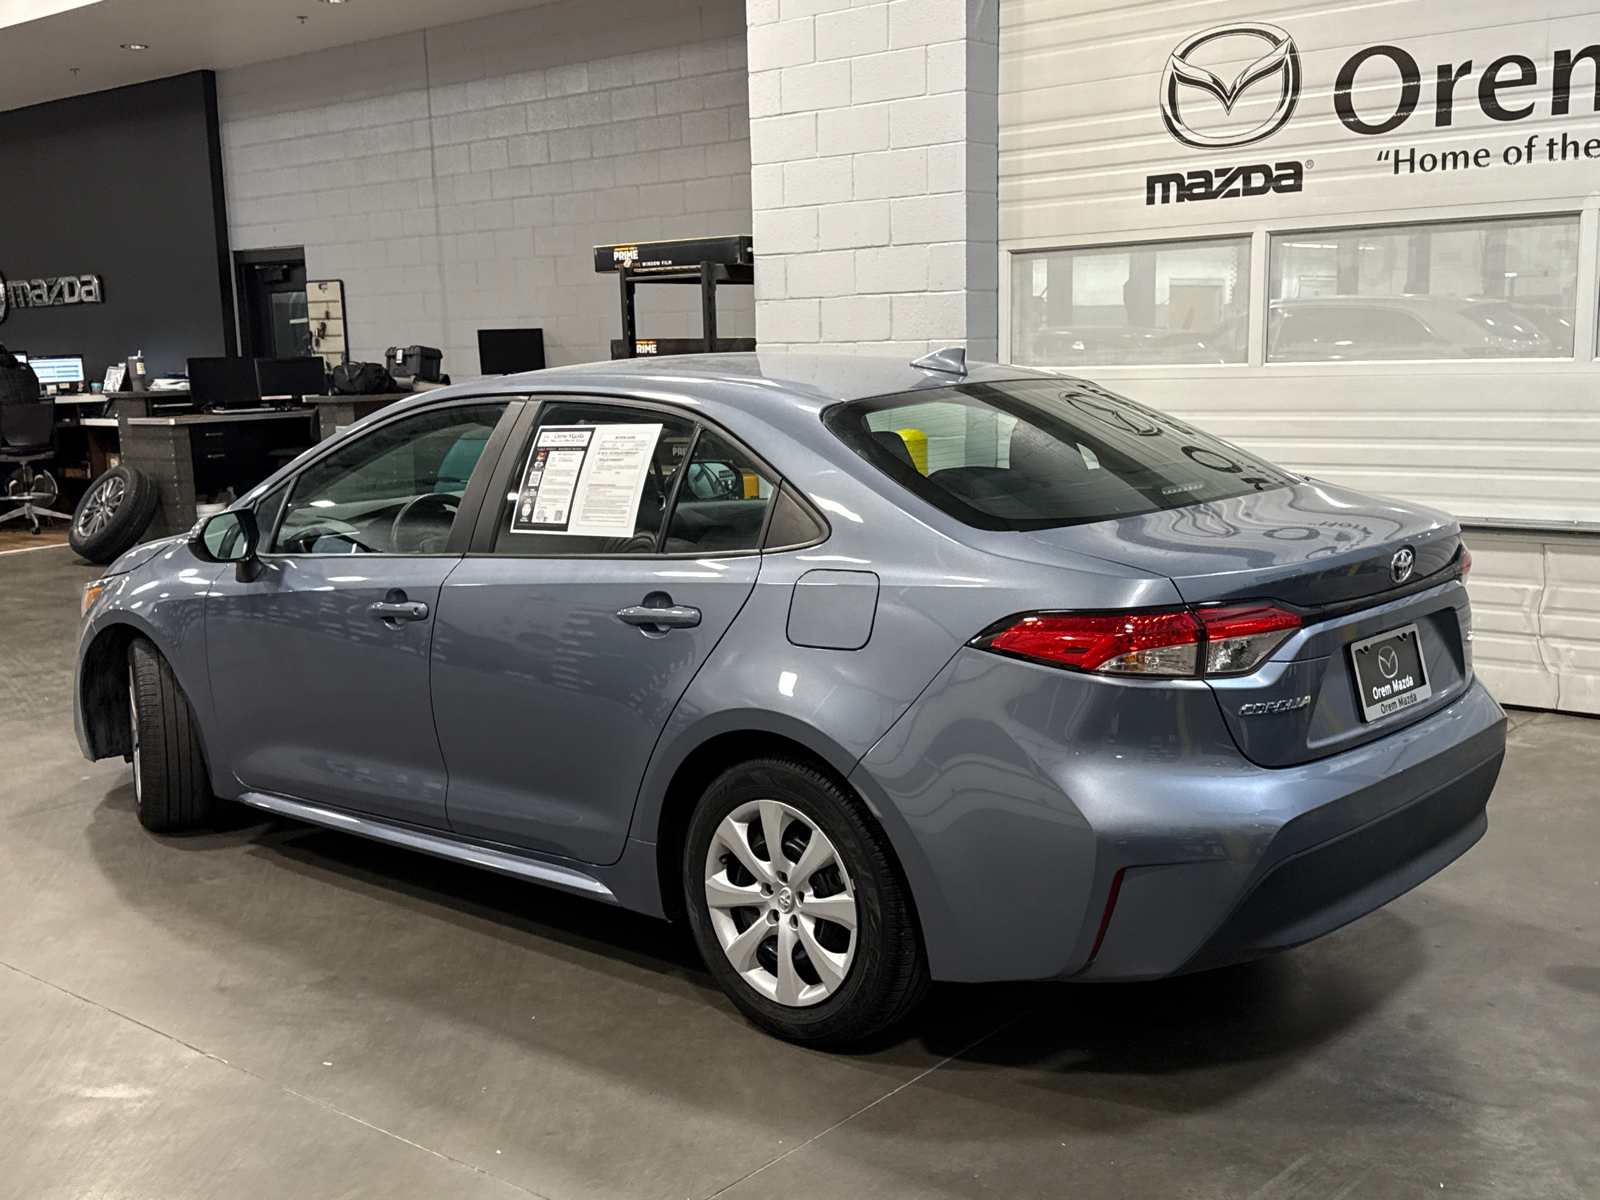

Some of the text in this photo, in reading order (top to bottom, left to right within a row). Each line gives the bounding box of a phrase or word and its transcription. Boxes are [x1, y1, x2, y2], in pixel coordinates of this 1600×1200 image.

[1502, 134, 1539, 166] of
[1545, 132, 1600, 162] the
[613, 250, 639, 261] PRIME
[636, 344, 657, 354] RIME
[1372, 674, 1414, 700] Orem Mazda
[1238, 695, 1311, 715] COROLLA
[1380, 692, 1418, 714] Orem Mazda
